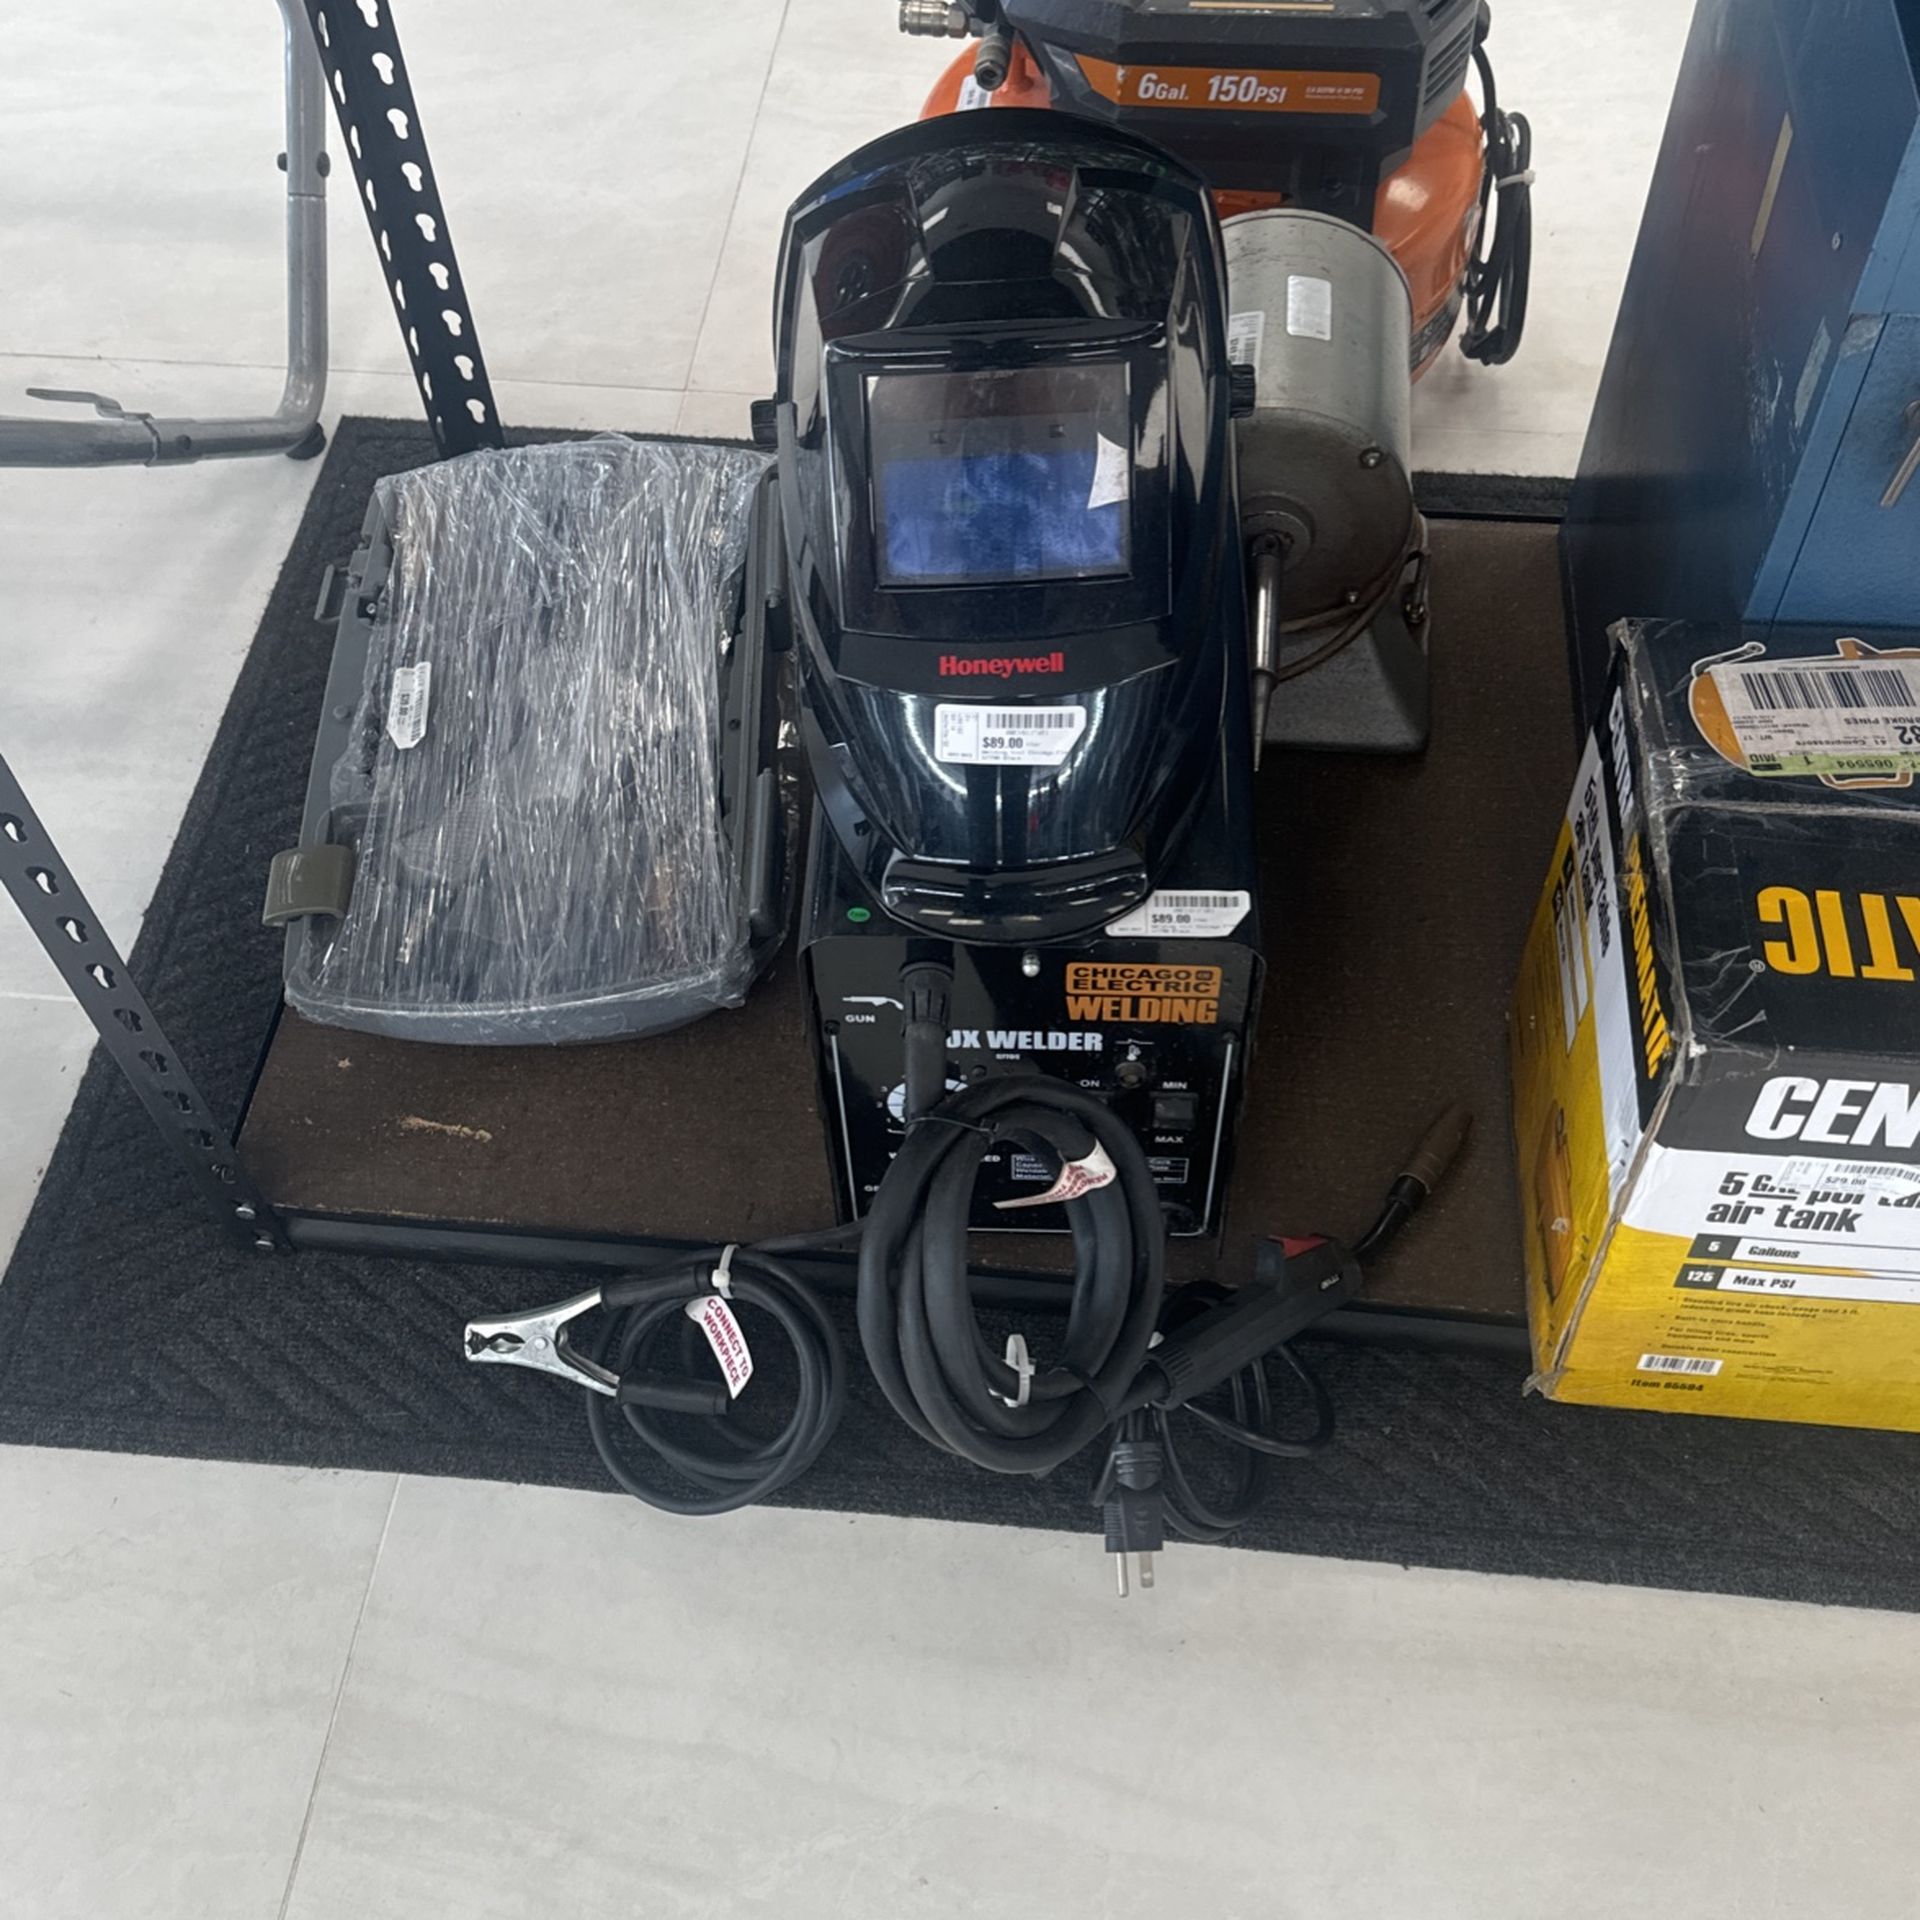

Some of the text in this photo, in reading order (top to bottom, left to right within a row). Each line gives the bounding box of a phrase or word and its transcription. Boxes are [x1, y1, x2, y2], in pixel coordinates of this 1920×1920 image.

[938, 651, 1065, 679] Honeywell
[982, 736, 1025, 750] $89.00
[1750, 753, 1777, 763] MID
[1073, 967, 1192, 980] CHICAGO
[1073, 978, 1212, 993] ELECTRIC
[1066, 995, 1219, 1024] WELDING
[845, 1014, 876, 1023] GUN
[986, 1030, 1104, 1051] WELDER
[1080, 1079, 1101, 1087] ON
[1162, 1081, 1188, 1090] MIN
[1718, 1171, 1749, 1196] 5
[1705, 1200, 1863, 1233] air tank
[1708, 1241, 1800, 1259] 5 Gallons
[1732, 1275, 1768, 1287] Max
[1769, 1278, 1797, 1289] PSI
[706, 1298, 750, 1378] CONNECT TO
[703, 1310, 742, 1387] WORKPIECE
[1630, 1379, 1661, 1389] Item
